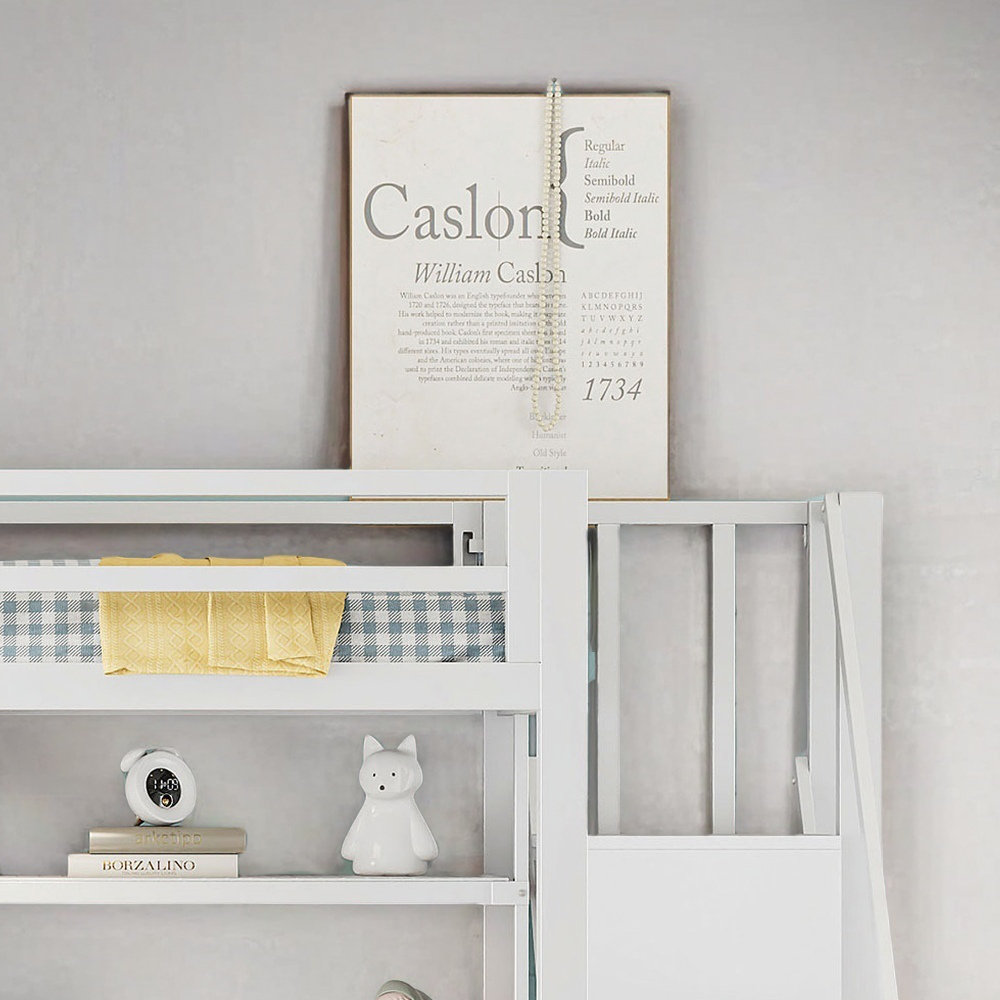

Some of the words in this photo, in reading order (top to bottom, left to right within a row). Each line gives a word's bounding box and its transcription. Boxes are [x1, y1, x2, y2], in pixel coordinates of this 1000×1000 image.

[584, 139, 625, 154] Regular
[584, 157, 610, 169] Italic
[584, 174, 635, 186] Semibold
[584, 191, 631, 203] Semibold
[633, 191, 660, 203] Italic
[364, 183, 551, 240] Caslon
[584, 209, 611, 221] Bold
[584, 227, 609, 239] Bold
[610, 227, 638, 239] Italic
[415, 262, 491, 283] William
[582, 377, 643, 401] 1734
[533, 448, 547, 457] Old
[549, 448, 567, 460] Style
[135, 830, 202, 847] arketipo
[102, 860, 196, 871] BORZALINO
